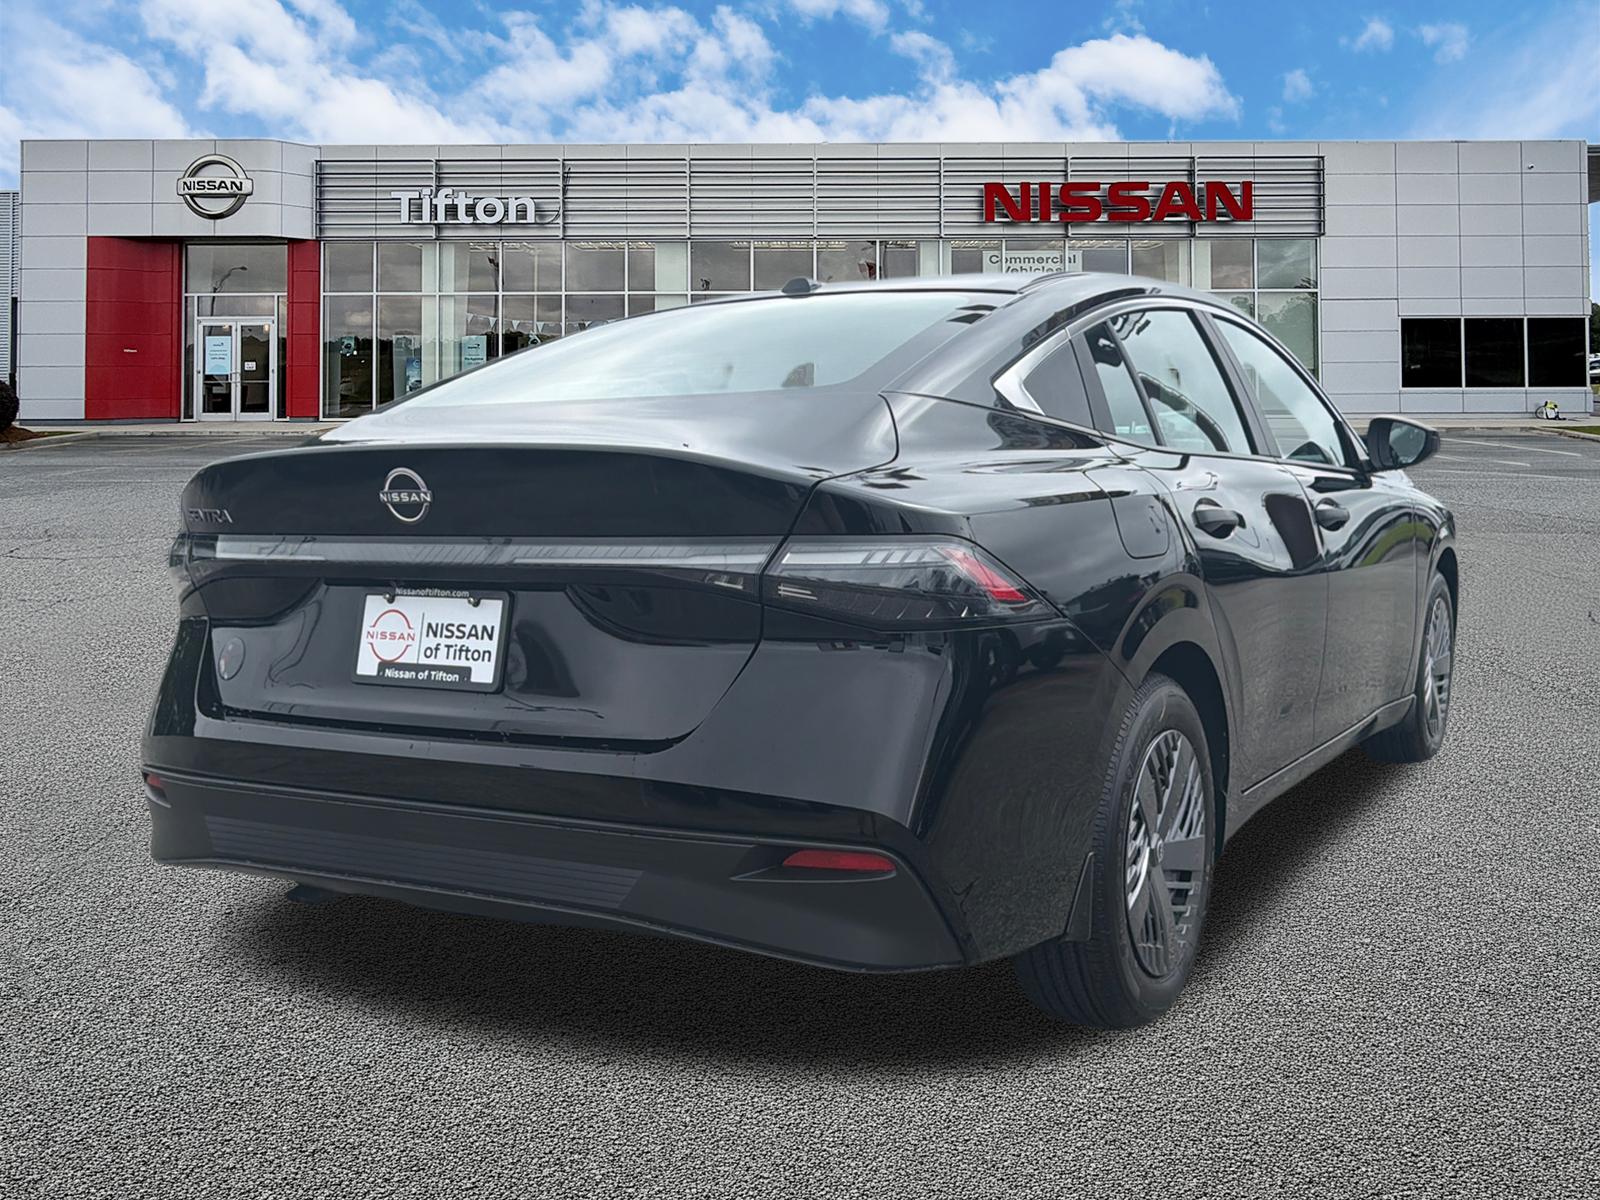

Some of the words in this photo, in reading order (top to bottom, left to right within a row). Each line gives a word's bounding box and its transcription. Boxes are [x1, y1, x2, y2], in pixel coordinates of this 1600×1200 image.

[183, 180, 243, 191] NISSAN
[391, 187, 536, 224] Tifton
[984, 181, 1253, 222] NISSAN
[379, 492, 431, 502] NISSAN
[395, 588, 469, 598] Nissanoftifton.com
[366, 630, 415, 642] NISSAN
[425, 622, 495, 641] NISSAN
[423, 643, 442, 659] of
[444, 644, 492, 662] Tifton
[384, 667, 415, 679] Nissan
[417, 669, 428, 679] of
[430, 670, 459, 682] Tifton
